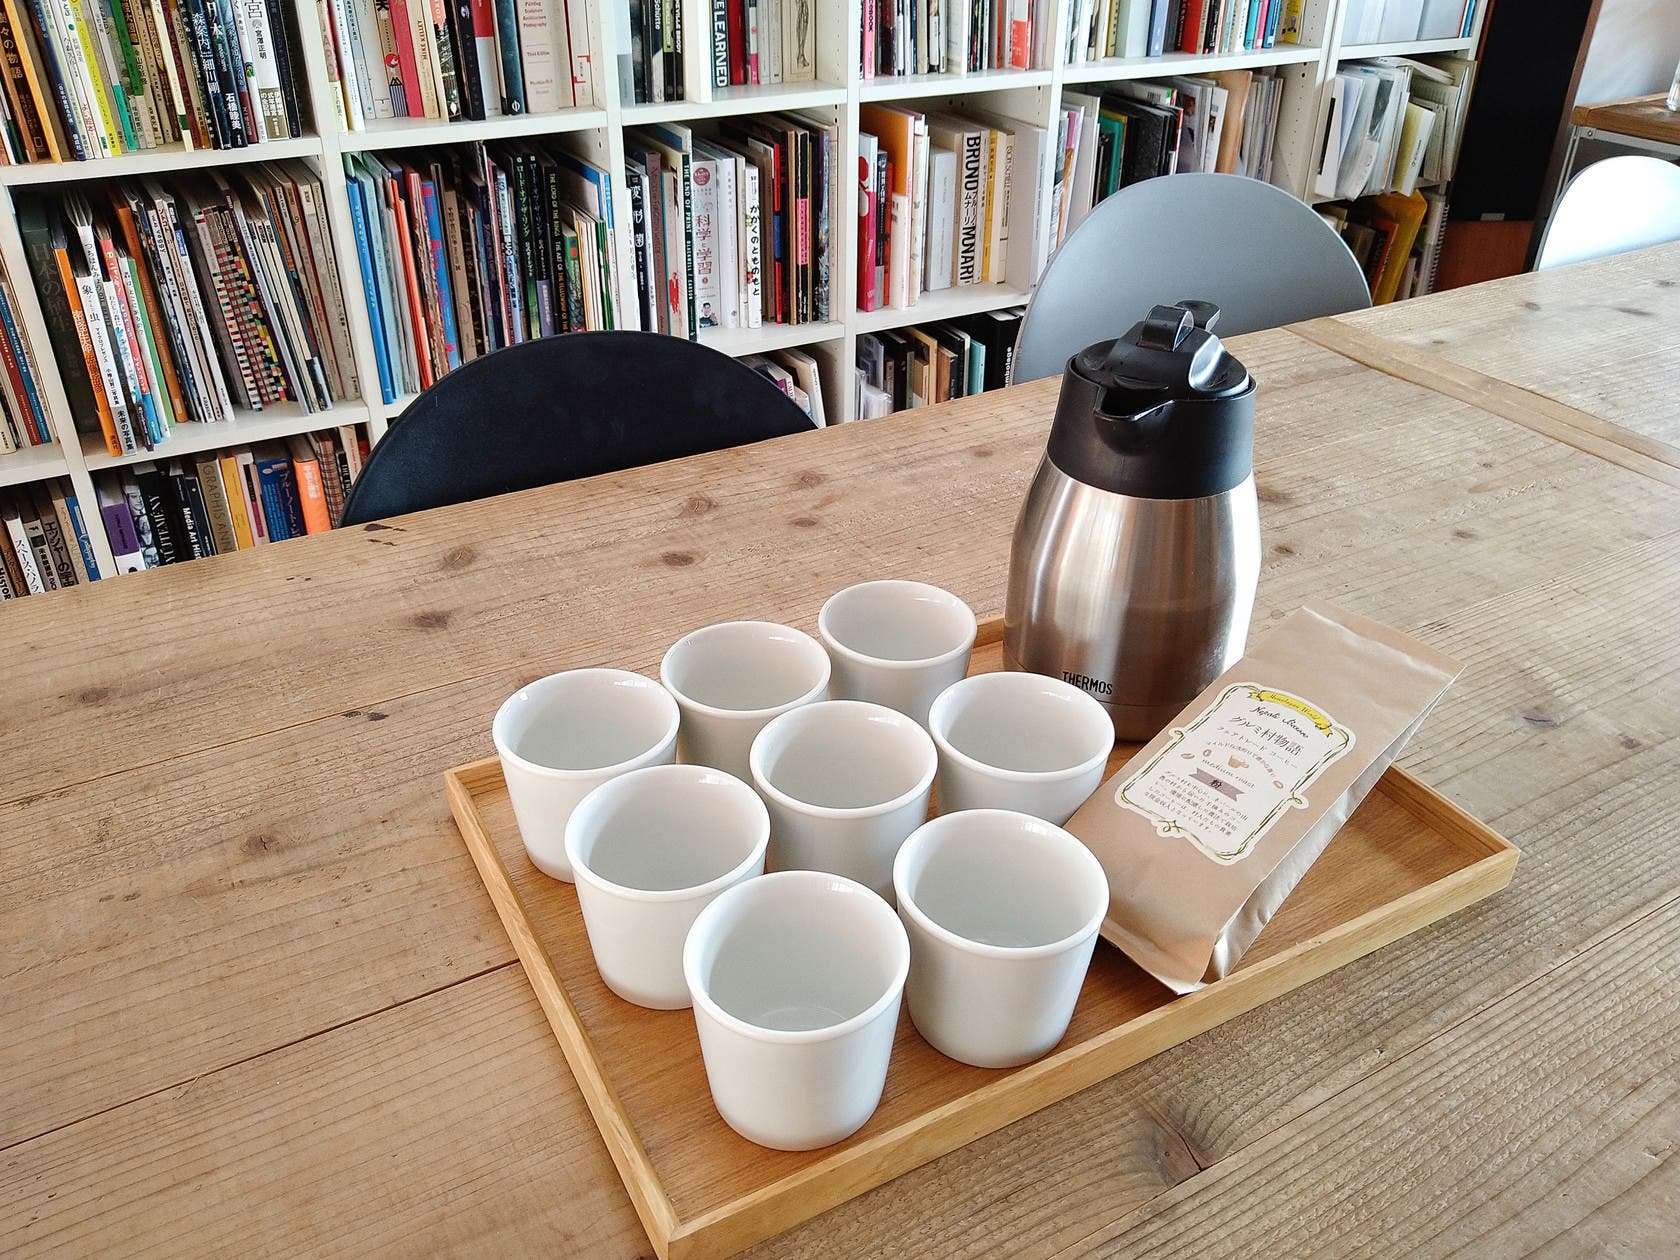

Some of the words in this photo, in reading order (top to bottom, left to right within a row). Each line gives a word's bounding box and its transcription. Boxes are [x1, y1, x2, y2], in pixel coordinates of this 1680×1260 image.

[714, 11, 728, 87] LEARNED
[964, 136, 981, 191] BRUNO
[695, 213, 713, 276] 科学と学習
[749, 204, 762, 298] かがくのとものもと
[959, 226, 978, 281] MUNARI
[182, 506, 195, 531] Media
[190, 530, 198, 545] Art
[1062, 671, 1113, 695] THERMOS
[1228, 714, 1305, 757] グルミ村物語
